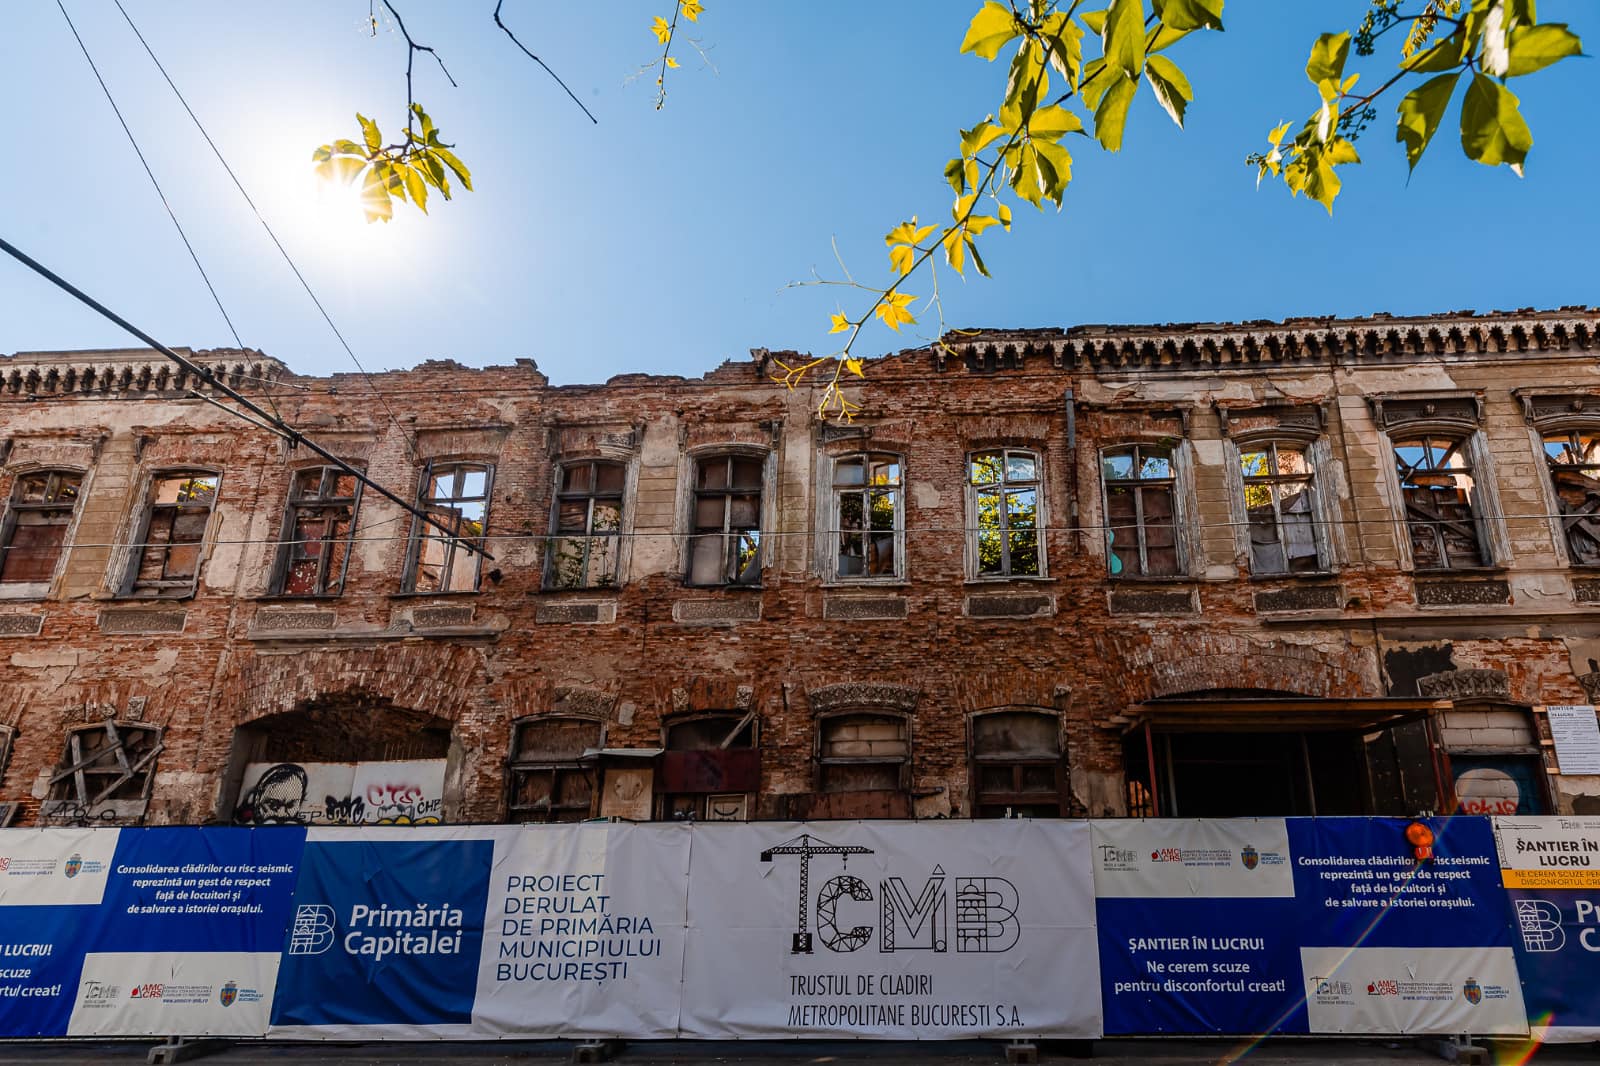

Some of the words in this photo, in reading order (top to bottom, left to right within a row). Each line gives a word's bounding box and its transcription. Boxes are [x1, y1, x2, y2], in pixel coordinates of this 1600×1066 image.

[1516, 839, 1579, 854] ȘANTIER
[1581, 838, 1599, 852] ÎN
[1298, 856, 1366, 866] Consolidarea
[1451, 856, 1490, 865] seismic
[1539, 856, 1590, 866] LUCRU
[117, 864, 179, 874] Consolidarea
[181, 864, 223, 873] clădirilor
[224, 865, 236, 873] cu
[238, 864, 255, 873] risc
[257, 864, 293, 873] seismic
[1320, 870, 1374, 881] reprezintă
[1393, 870, 1415, 881] gest
[1417, 870, 1431, 879] de
[1433, 871, 1471, 881] respect
[132, 877, 182, 888] reprezintă
[183, 878, 197, 886] un
[198, 878, 219, 888] gest
[220, 877, 233, 886] de
[234, 877, 271, 888] respect
[507, 873, 604, 892] PROIECT
[1374, 884, 1388, 893] de
[1389, 884, 1435, 893] locuitori
[1521, 878, 1584, 886] DISCONFORTUL
[176, 890, 189, 900] de
[190, 890, 231, 900] locuitori
[127, 904, 139, 914] de
[140, 903, 176, 914] salvare
[178, 905, 184, 914] a
[185, 903, 219, 914] istoriei
[504, 896, 610, 914] DERULAT
[1325, 897, 1340, 907] de
[1341, 897, 1379, 907] salvare
[1380, 899, 1388, 907] a
[1389, 897, 1427, 907] istoriei
[349, 902, 463, 928] Primăria
[501, 918, 533, 936] DE
[540, 914, 654, 935] PRIMĂRIA
[4, 944, 53, 956] LUCRU!
[344, 929, 462, 961] Capitalei
[499, 938, 661, 959] MUNICIPIULUI
[1128, 938, 1189, 953] ȘANTIER
[1192, 936, 1208, 950] ÎN
[1212, 938, 1265, 950] LUCRU!
[496, 961, 628, 986] BUCUREȘTI
[1147, 961, 1165, 973] Ne
[1167, 963, 1209, 973] cerem
[1212, 963, 1250, 973] scuze
[21, 984, 61, 997] creat!
[789, 975, 852, 996] TRUSTUL
[857, 975, 875, 995] DE
[880, 975, 933, 995] CLADIRI
[1115, 980, 1160, 995] pentru
[1163, 979, 1245, 992] disconfortul
[1248, 979, 1286, 992] creat!
[787, 1005, 905, 1026] METROPOLITANE
[911, 1005, 990, 1026] BUCURESTI
[996, 1005, 1025, 1026] S.A.
